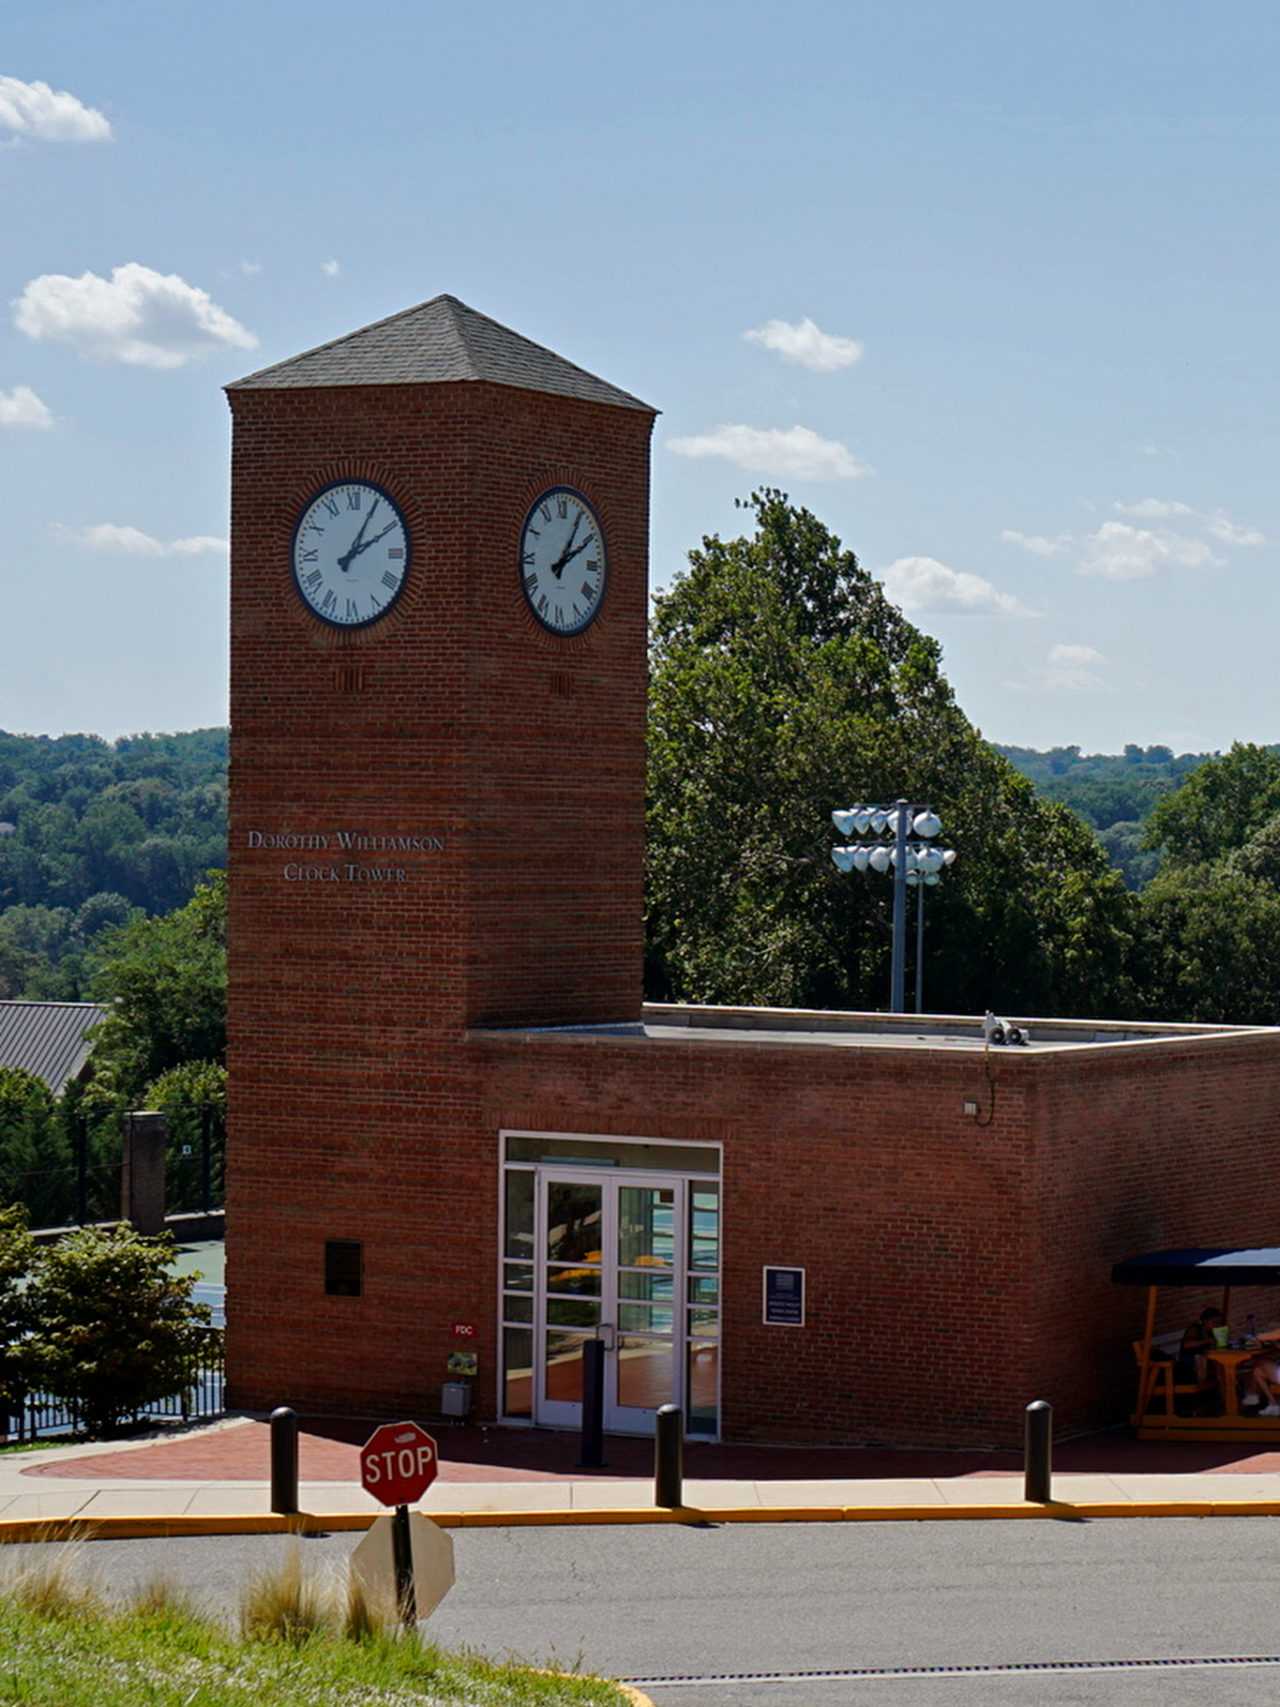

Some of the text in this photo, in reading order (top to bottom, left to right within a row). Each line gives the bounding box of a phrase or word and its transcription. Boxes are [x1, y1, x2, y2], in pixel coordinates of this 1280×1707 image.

[248, 831, 444, 850] DOROTHY WILLIAMSON
[283, 863, 407, 882] CLOCK TOWER
[366, 1446, 432, 1483] STOP
